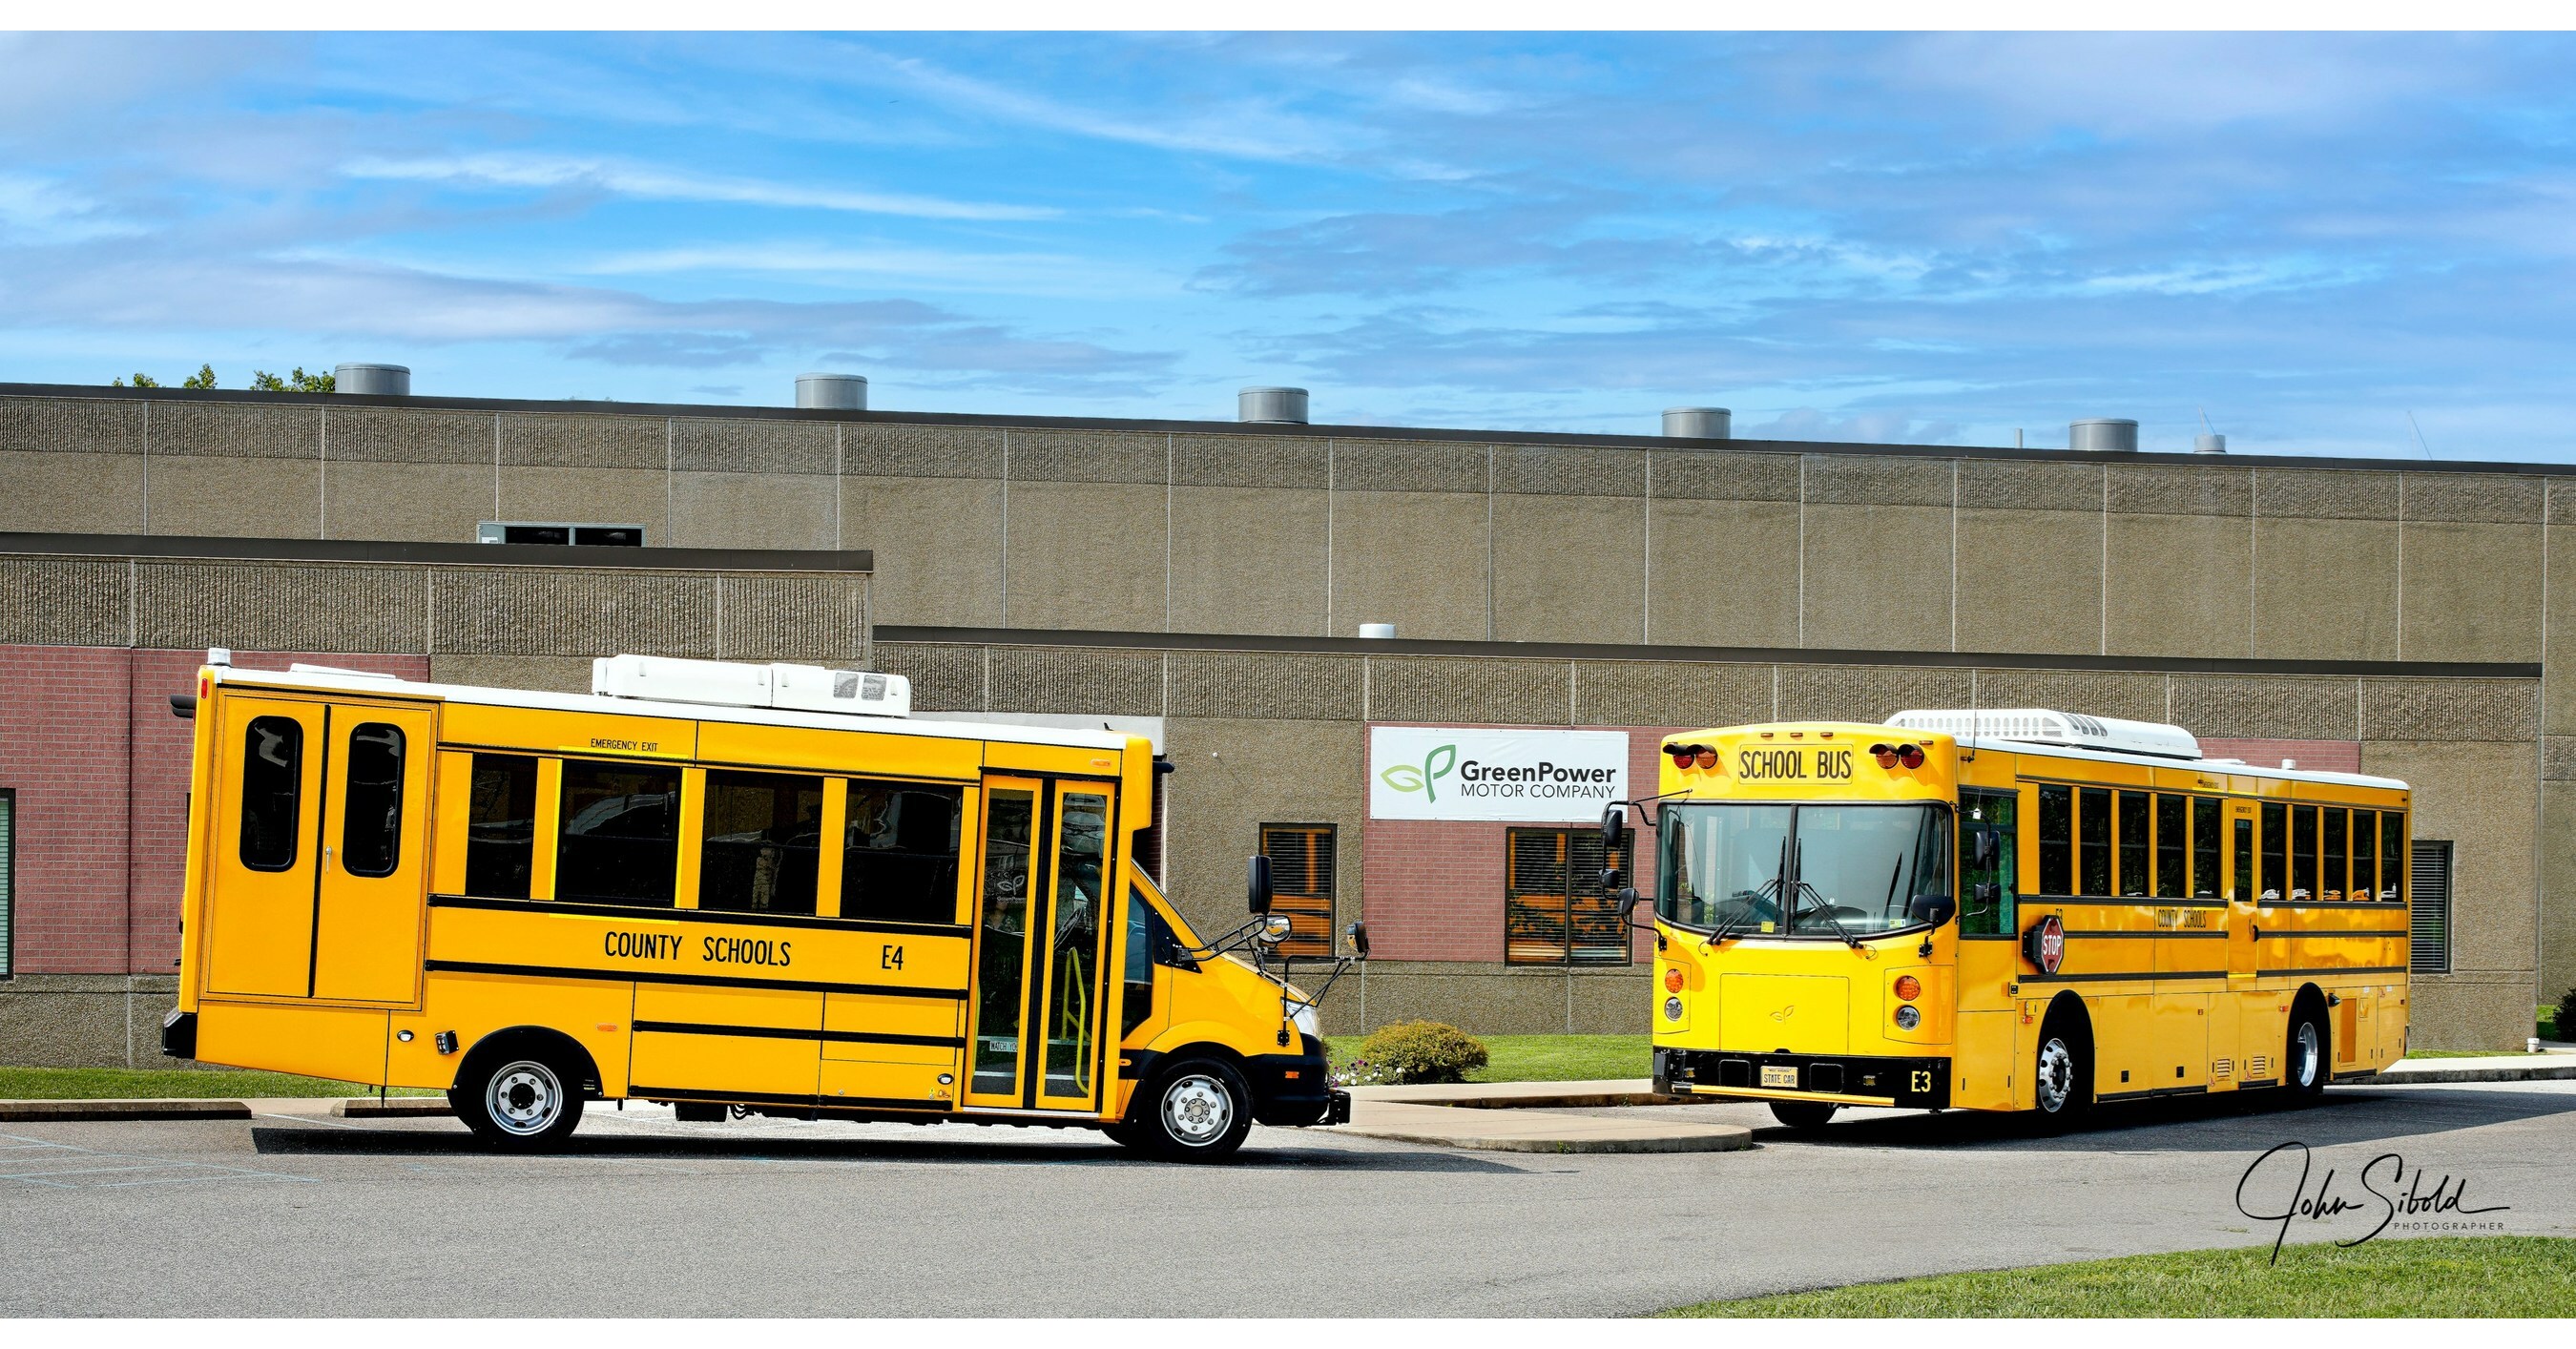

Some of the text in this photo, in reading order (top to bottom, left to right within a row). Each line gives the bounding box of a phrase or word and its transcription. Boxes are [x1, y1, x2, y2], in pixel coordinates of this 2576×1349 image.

[591, 738, 657, 752] EMERGENCY EXIT
[1461, 760, 1616, 782] GreenPower
[1739, 750, 1852, 778] SCHOOL BUS
[1461, 783, 1615, 799] MOTOR COMPANY
[2157, 909, 2207, 928] COUNTY SCHOOLS
[604, 931, 904, 970] COUNTY SCHOOLS E4
[2043, 935, 2062, 955] STOP
[1763, 1073, 1781, 1084] STATE
[1911, 1070, 1931, 1092] E3
